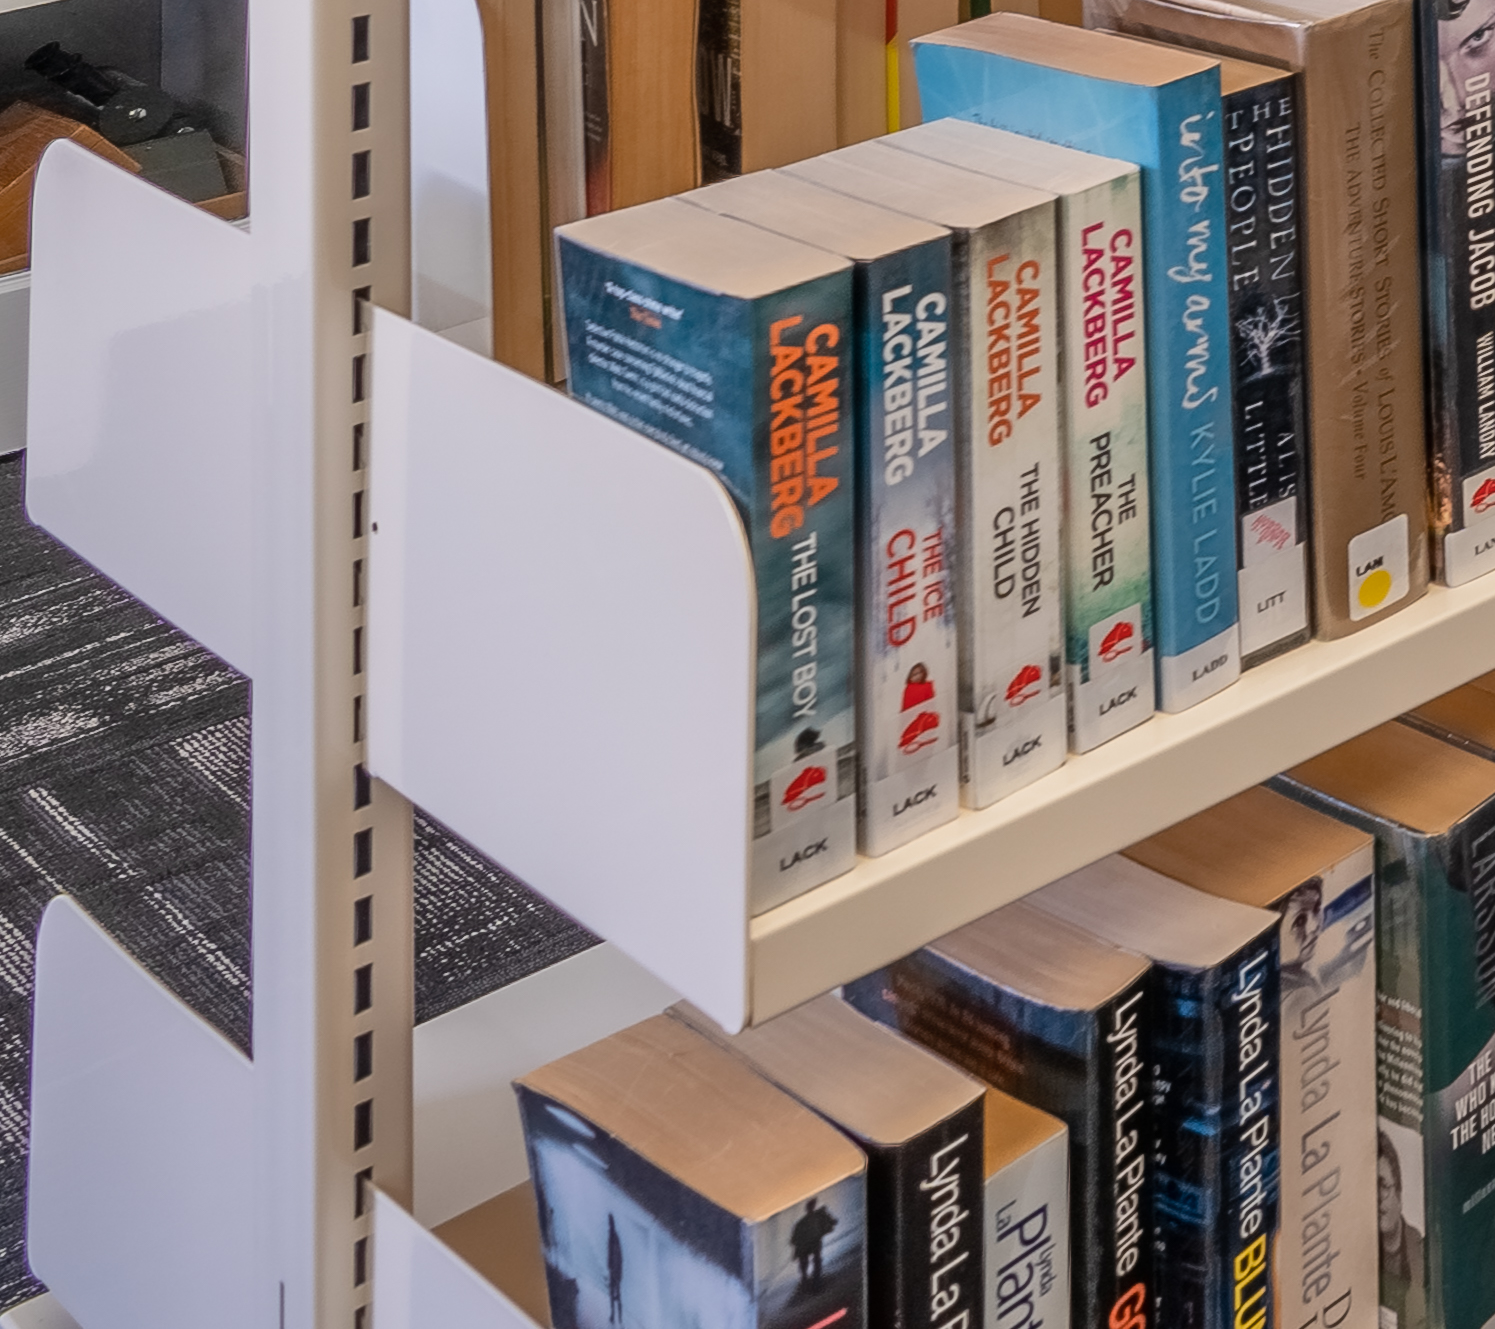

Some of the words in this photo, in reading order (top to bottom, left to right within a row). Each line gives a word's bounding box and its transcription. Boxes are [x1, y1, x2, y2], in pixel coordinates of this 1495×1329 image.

[1464, 72, 1495, 221] DEFENDING
[1467, 228, 1495, 311] JACOB
[769, 314, 805, 539] LACKBERG
[800, 323, 840, 508] CAMILLA
[790, 533, 819, 581] THE
[790, 584, 819, 655] LOST
[789, 658, 819, 719] BOY
[892, 783, 937, 816] LACK
[1107, 992, 1144, 1110] Lynda
[1468, 1050, 1492, 1085] THE
[1115, 1100, 1144, 1165] La
[1451, 1114, 1477, 1150] THE
[1455, 1082, 1486, 1121] WHO
[1115, 1154, 1145, 1276] Plante
